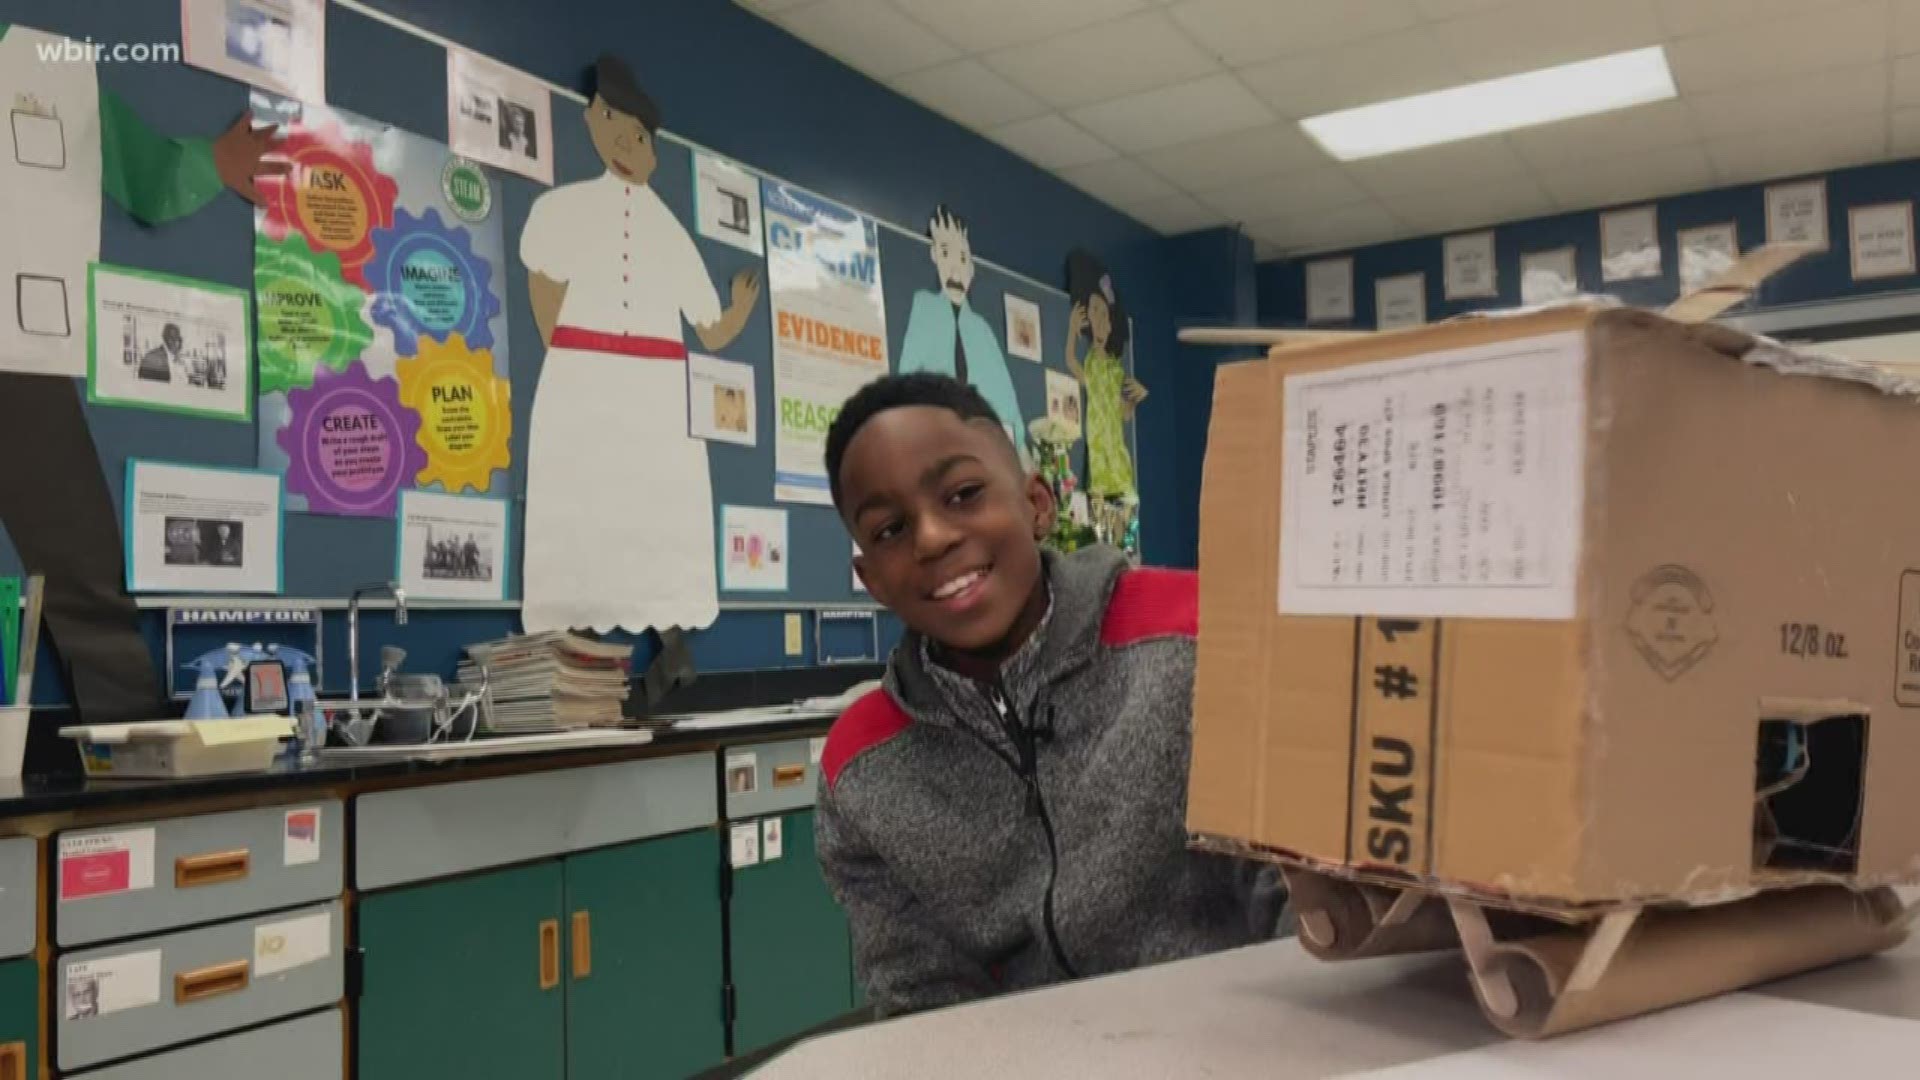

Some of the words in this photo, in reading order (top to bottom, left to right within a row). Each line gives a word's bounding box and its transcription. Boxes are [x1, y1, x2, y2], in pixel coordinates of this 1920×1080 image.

[310, 171, 347, 191] ASK
[770, 221, 876, 284] CLIM
[777, 311, 883, 361] EVIDENCE
[432, 385, 473, 403] PLAN
[323, 413, 379, 432] CREATE
[1332, 423, 1347, 507] 126464
[182, 610, 310, 622] HAMPTON
[1781, 622, 1819, 661] 12/8
[1374, 664, 1419, 699] #
[1368, 736, 1416, 866] SKU
